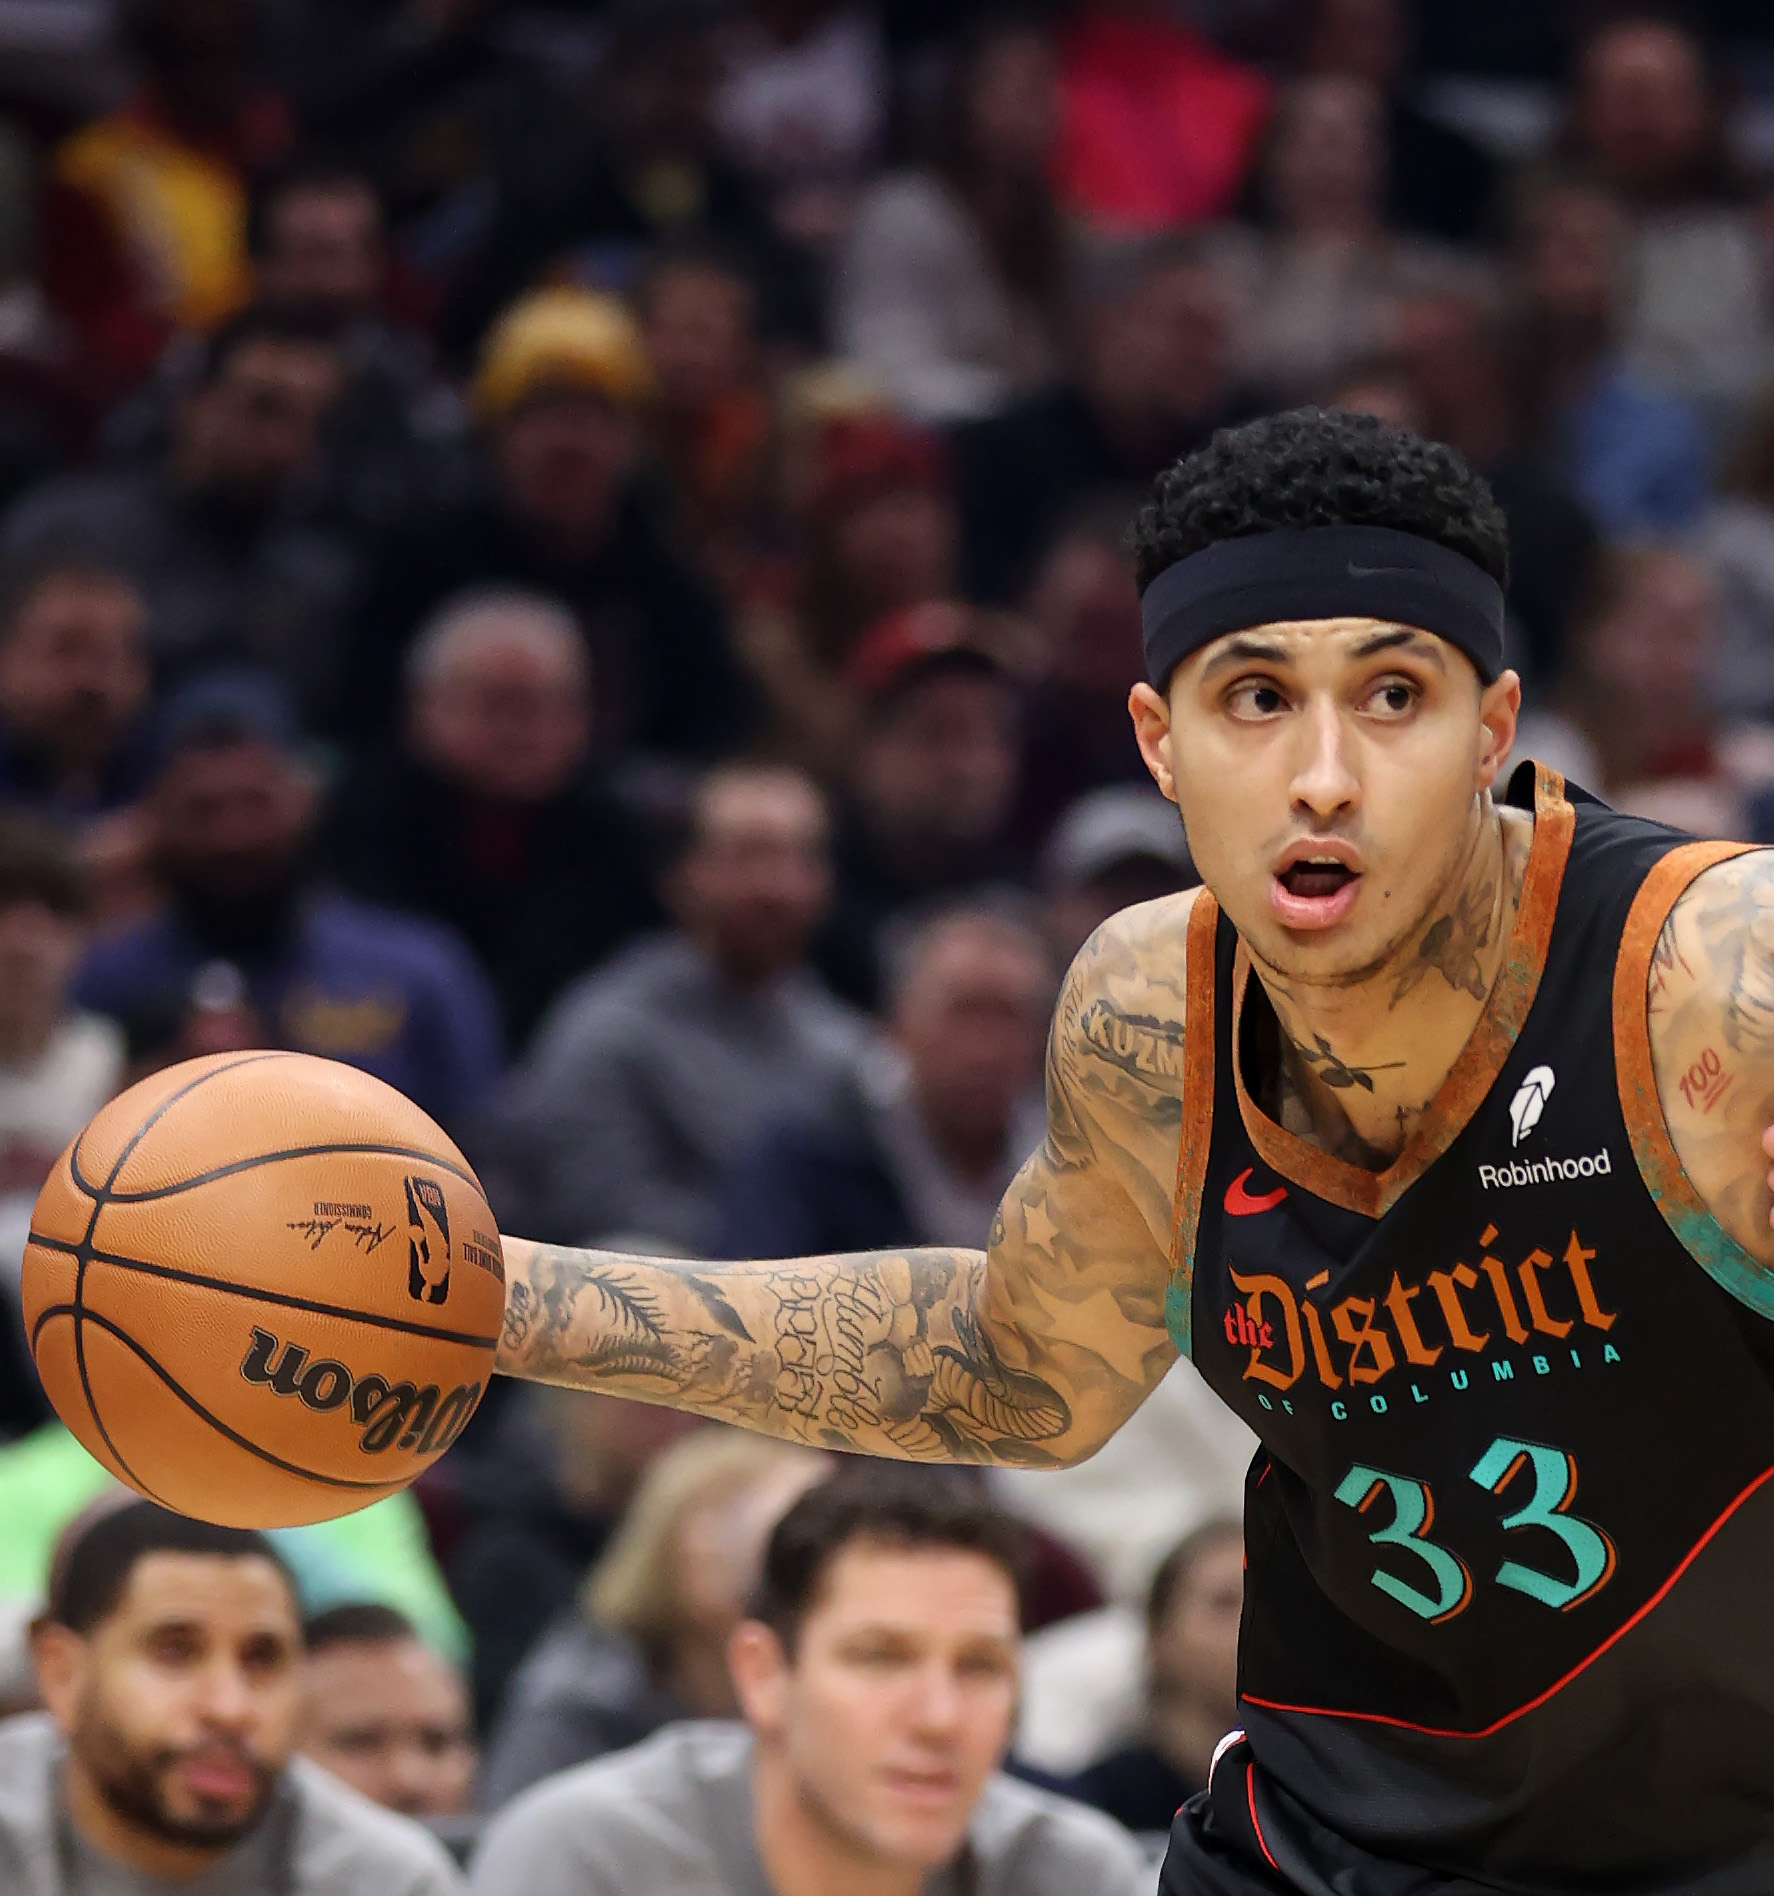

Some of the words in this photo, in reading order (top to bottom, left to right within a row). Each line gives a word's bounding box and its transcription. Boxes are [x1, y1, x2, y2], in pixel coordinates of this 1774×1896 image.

[1089, 1001, 1185, 1080] KUZM
[1478, 1149, 1613, 1191] Robinhood
[1223, 1302, 1276, 1350] the
[1229, 1222, 1619, 1392] District
[239, 1325, 482, 1454] Wilson
[1257, 1393, 1295, 1416] OF
[1331, 1343, 1621, 1421] COLUMBIA
[1333, 1432, 1620, 1626] 33
